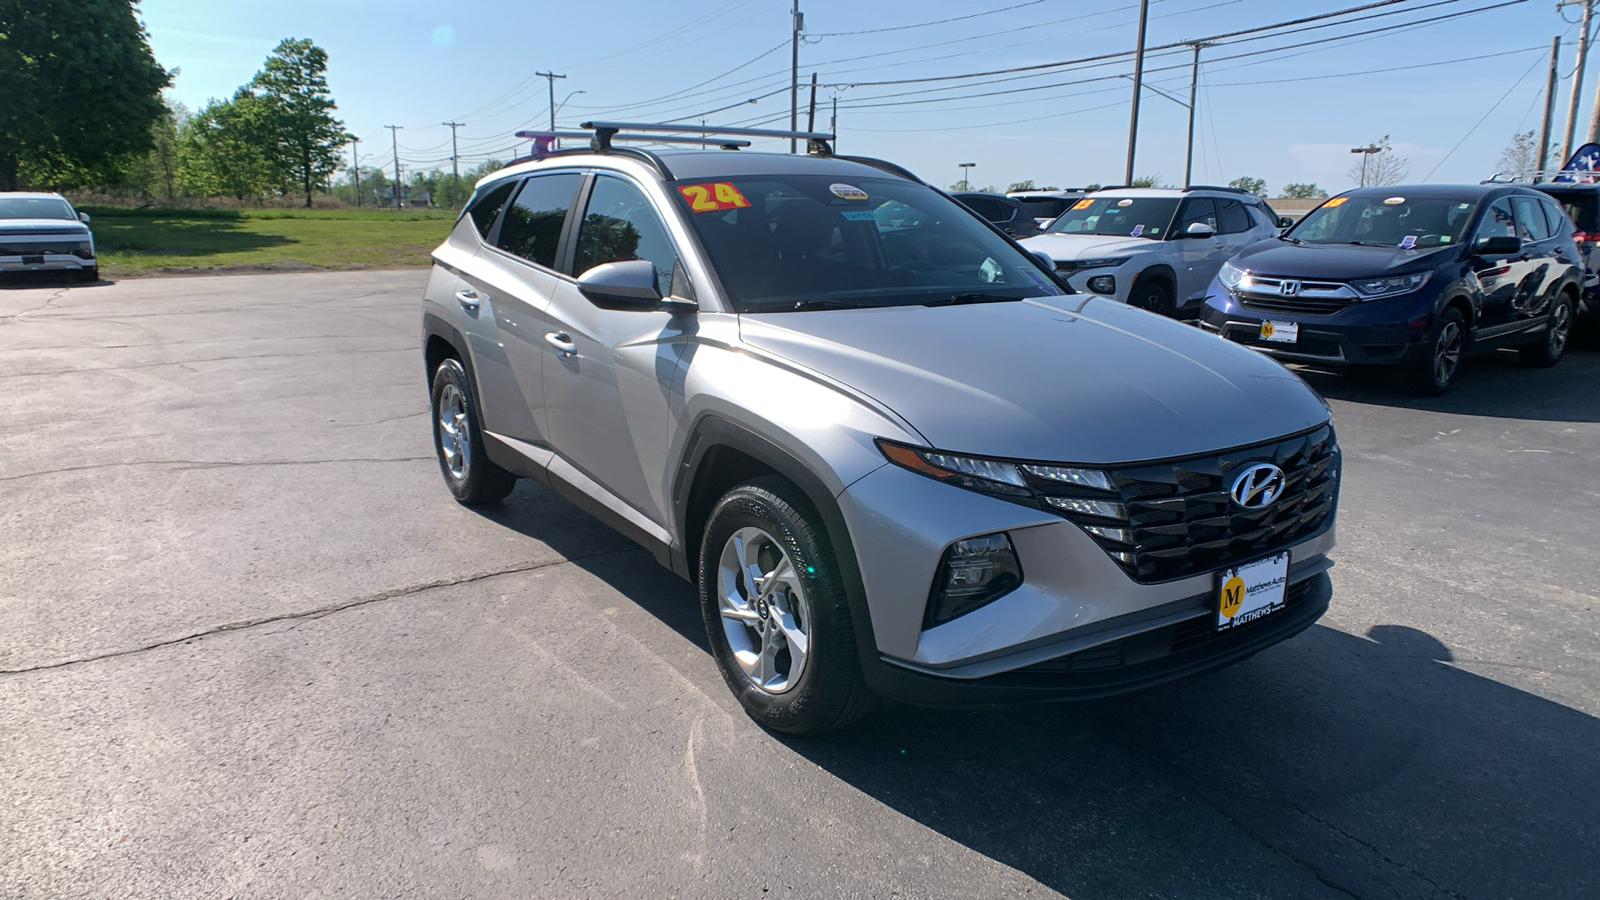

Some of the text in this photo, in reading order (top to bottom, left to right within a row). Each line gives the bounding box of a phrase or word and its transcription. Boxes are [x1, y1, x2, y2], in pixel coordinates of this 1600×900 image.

[682, 183, 746, 211] 24
[1223, 585, 1241, 609] M
[1245, 581, 1272, 595] Matthews
[1232, 606, 1271, 627] MATTHEWS
